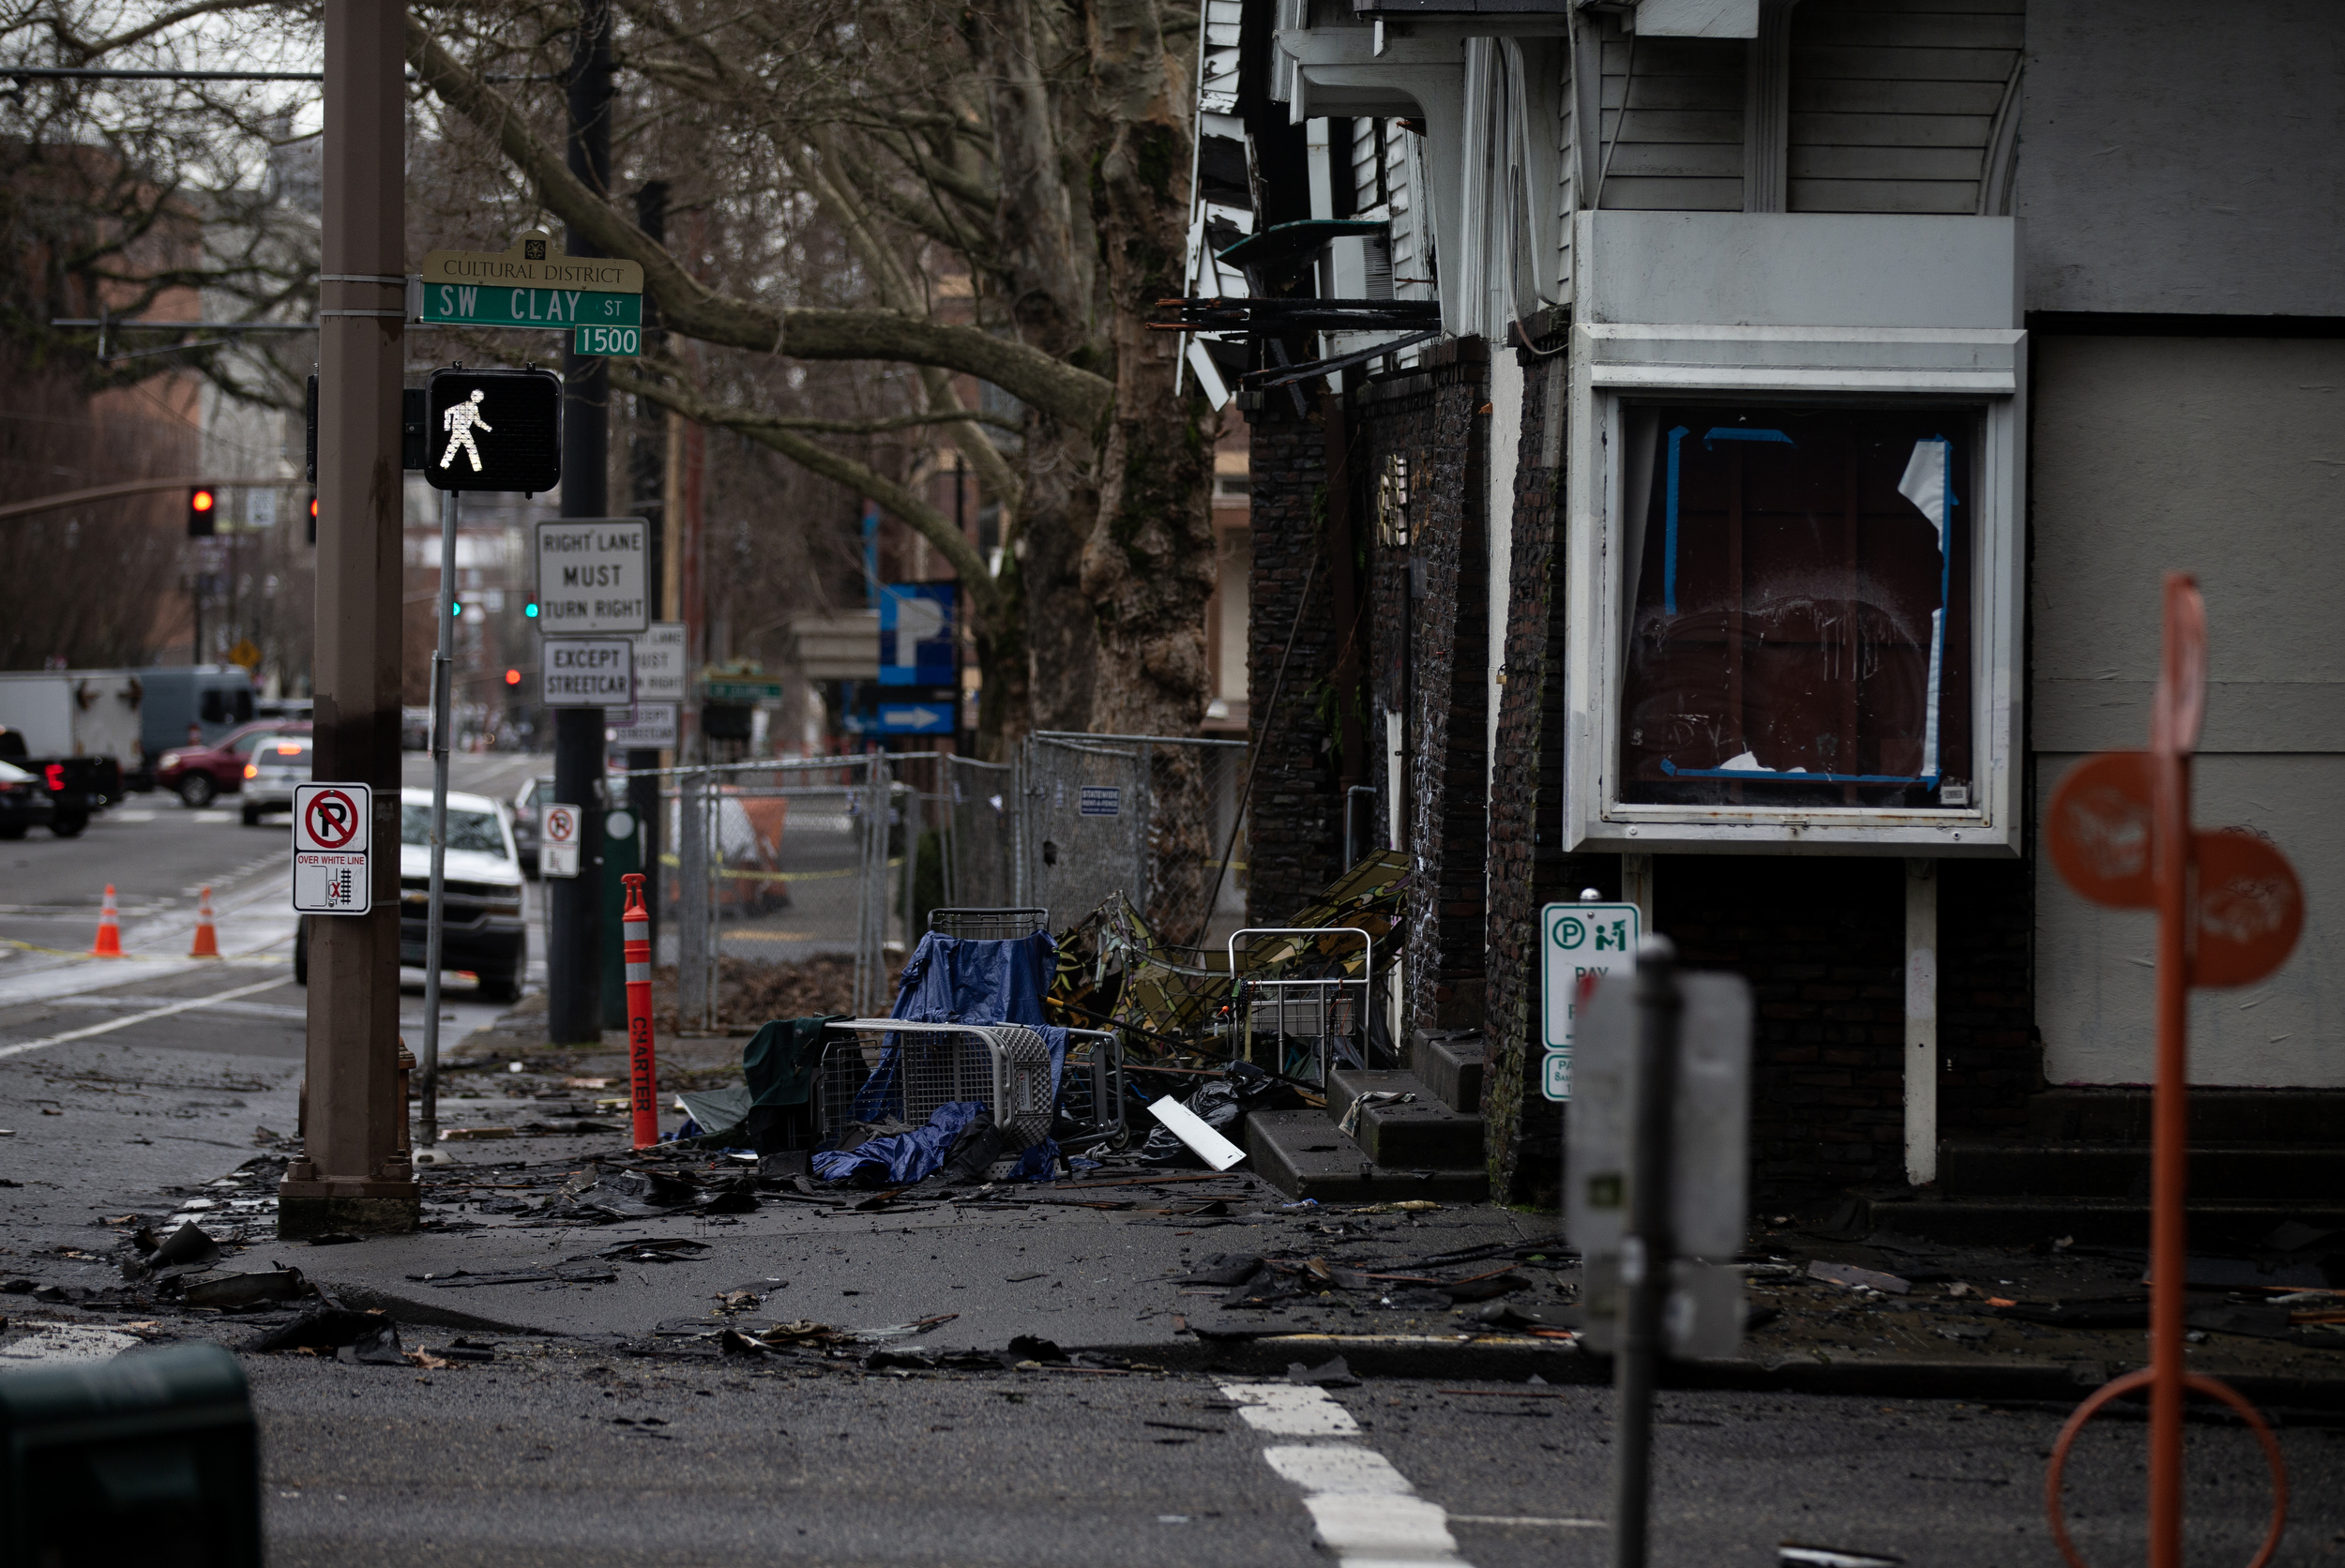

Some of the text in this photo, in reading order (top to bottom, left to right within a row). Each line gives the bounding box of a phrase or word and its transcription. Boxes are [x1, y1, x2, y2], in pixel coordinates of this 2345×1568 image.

[444, 260, 624, 283] CULTURAL DISTRICT
[440, 285, 623, 321] SW CLAY ST
[583, 328, 637, 354] 1500
[544, 533, 641, 552] RIGHT LANE
[564, 565, 622, 587] MUST
[544, 598, 643, 619] TURN RIGHT
[554, 649, 620, 669] EXCEPT
[547, 674, 628, 694] STREETCAR
[297, 855, 365, 865] OVER WHITE LINE
[632, 1017, 651, 1111] CHARTER
